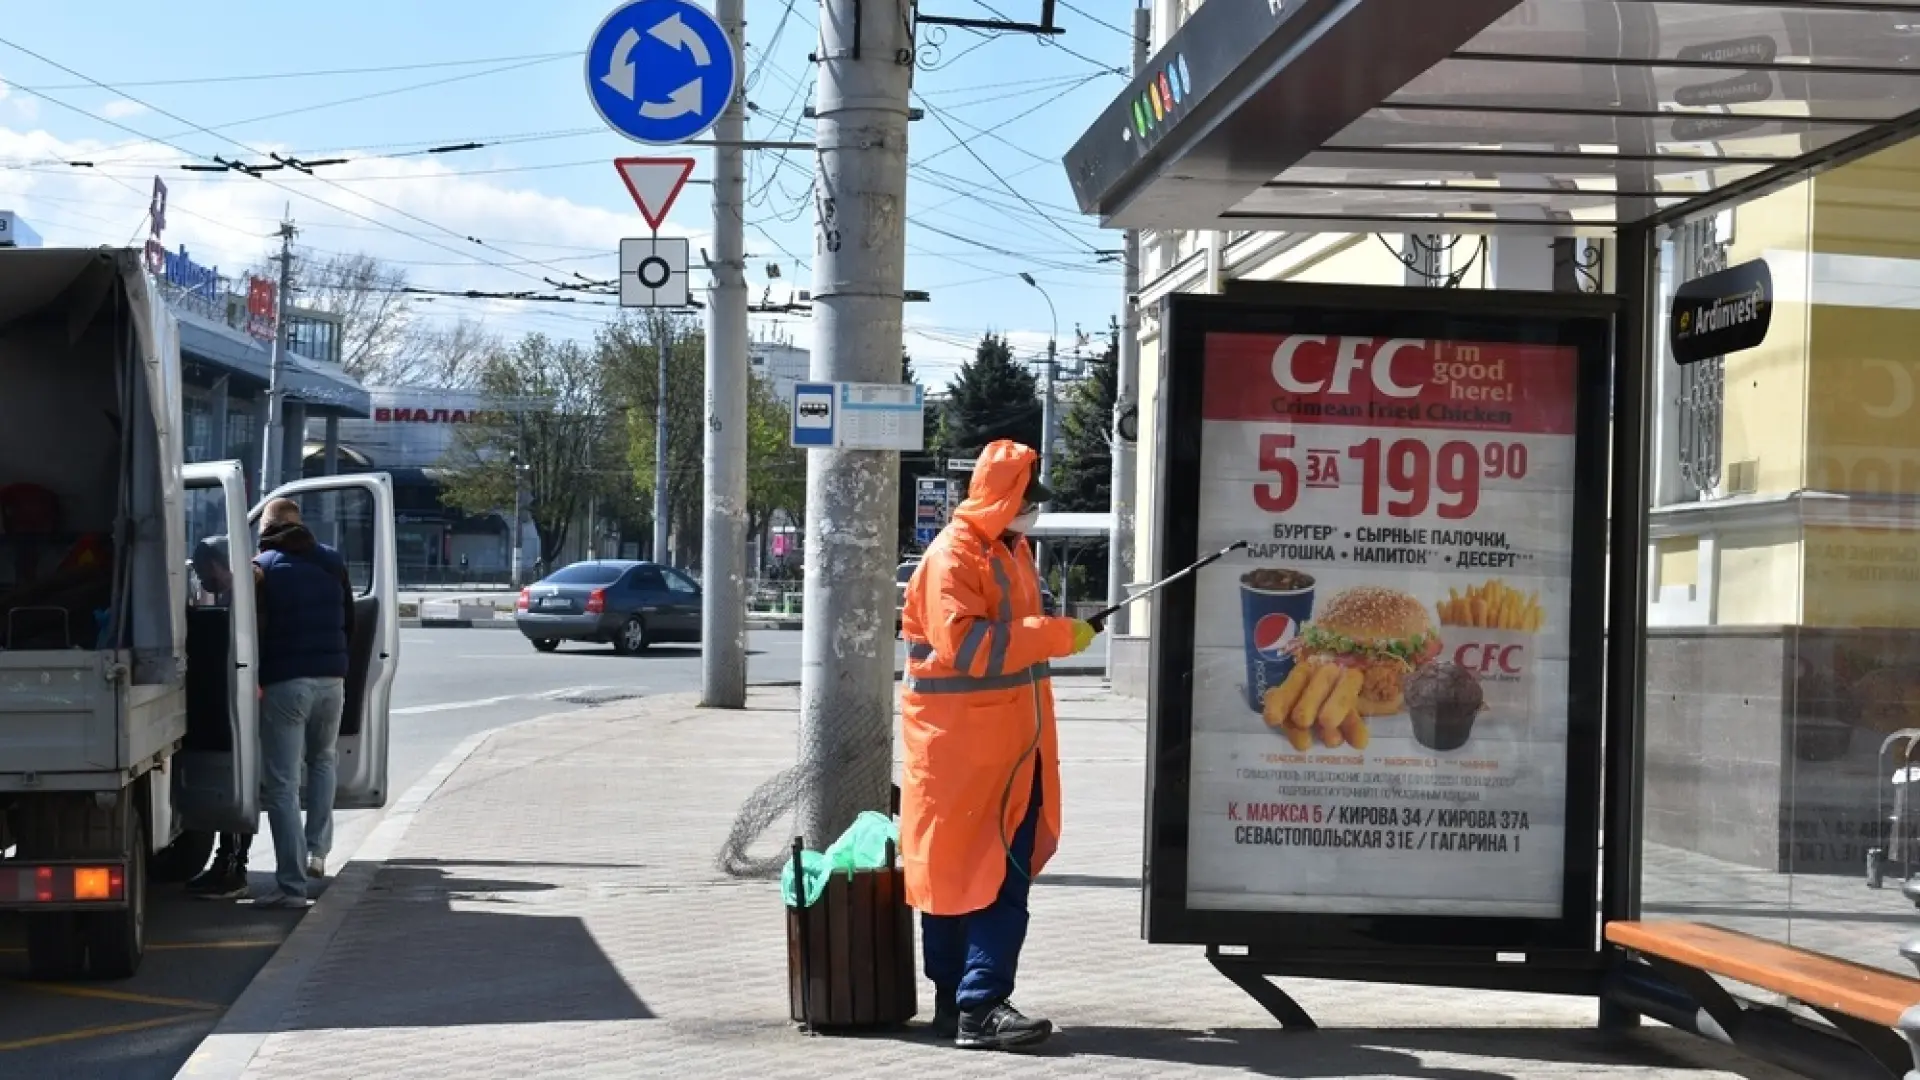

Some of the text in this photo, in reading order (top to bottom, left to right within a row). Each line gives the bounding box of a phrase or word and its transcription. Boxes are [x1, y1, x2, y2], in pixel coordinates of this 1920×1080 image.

[1695, 290, 1758, 336] Ardinvest
[1271, 334, 1426, 398] CFC
[1430, 359, 1505, 384] good
[1450, 380, 1513, 402] here!
[1271, 398, 1513, 424] Crimean Fried Chicken
[1253, 433, 1528, 520] 5 ЗА 199 90
[1356, 526, 1427, 545] СЫРНЫЕ
[1431, 530, 1511, 550] ПАЛОЧКИ,
[1453, 643, 1524, 673] CFC
[1228, 801, 1242, 821] К.
[1246, 802, 1309, 823] МАРКСА
[1339, 805, 1399, 826] КИРОВА
[1402, 808, 1421, 827] 34
[1438, 808, 1497, 829] КИРОВА
[1500, 810, 1529, 830] 37А
[1235, 825, 1382, 849] СЕВАСТОПОЛЬСКАЯ
[1386, 829, 1414, 850] 31Е
[1431, 831, 1508, 852] ГАГАРИНА
[1513, 834, 1521, 853] 1
